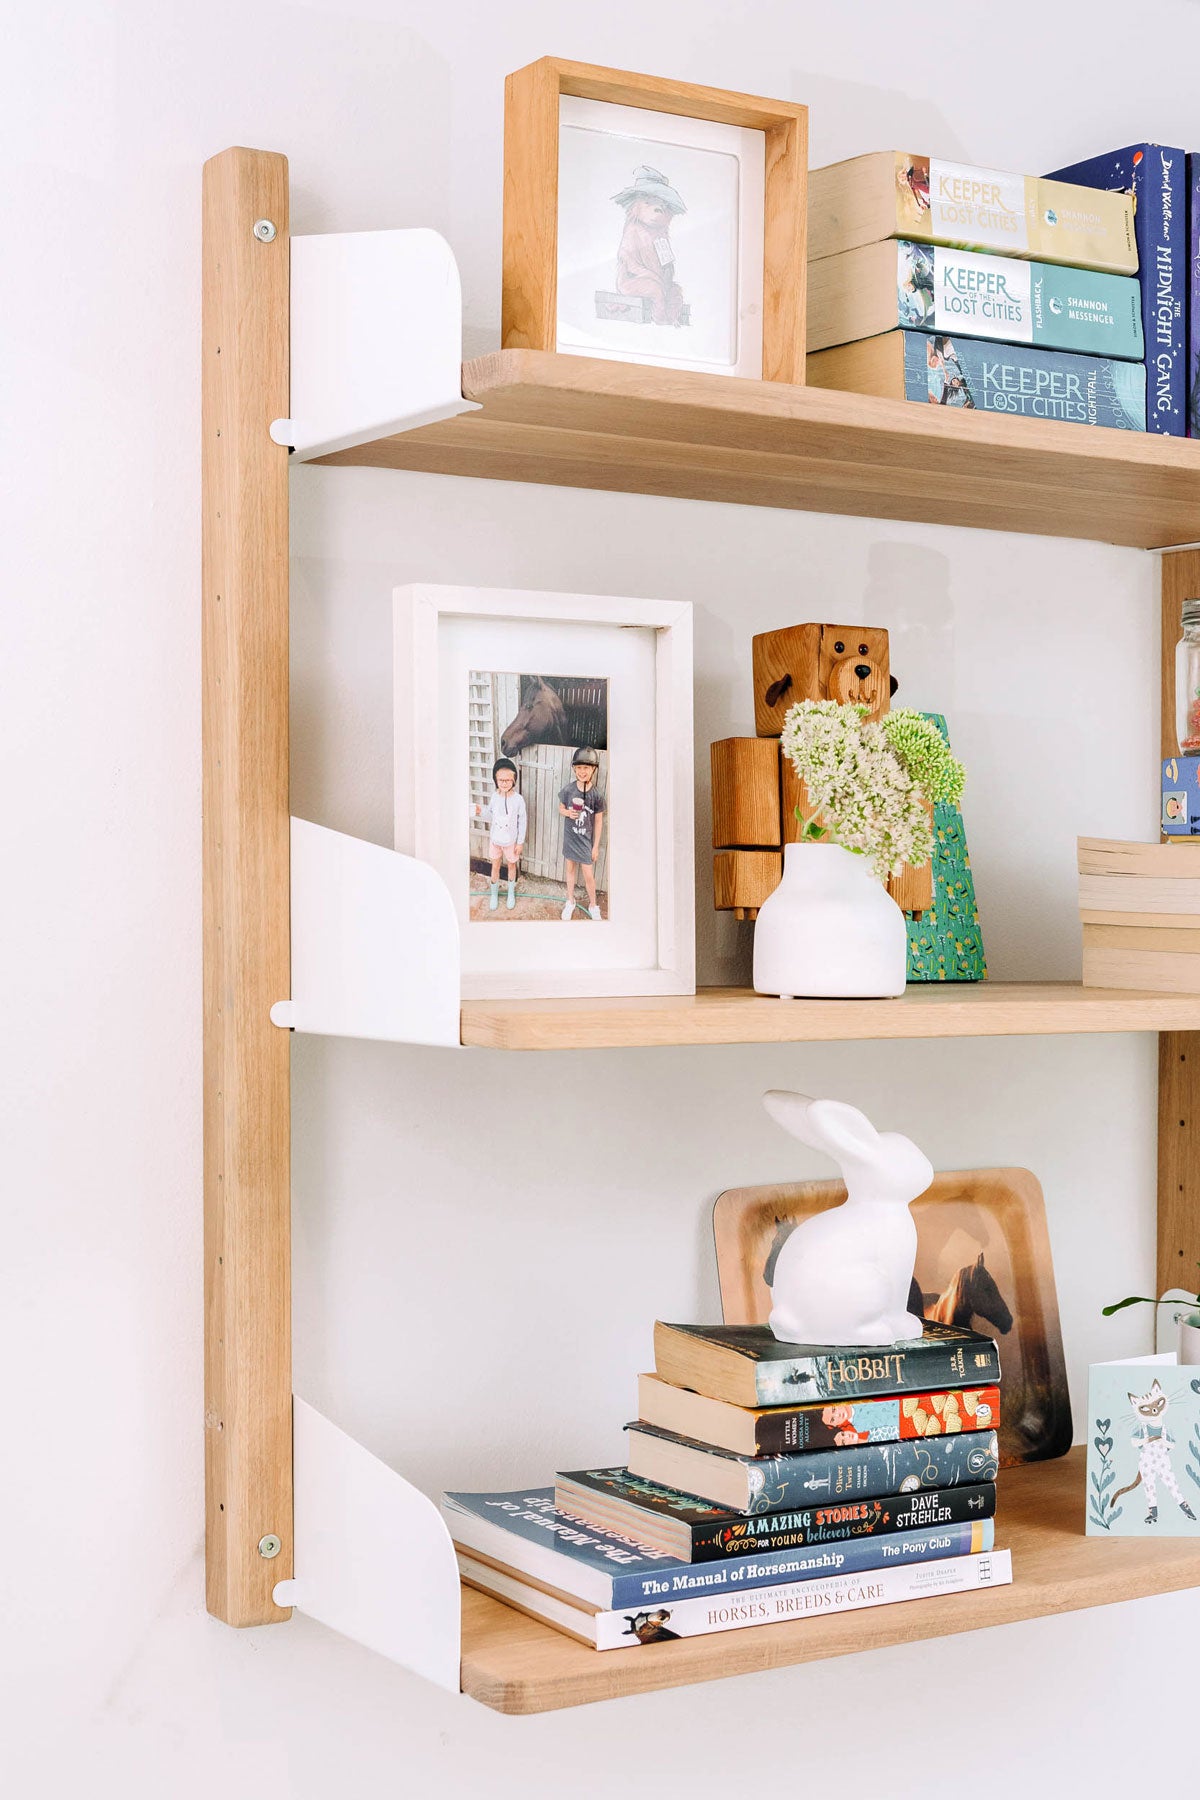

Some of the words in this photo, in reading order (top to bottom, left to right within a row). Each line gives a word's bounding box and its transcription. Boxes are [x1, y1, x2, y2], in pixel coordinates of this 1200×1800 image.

[938, 175, 1017, 214] KEEPER
[940, 205, 974, 225] LOST
[977, 208, 1018, 233] CITIES
[944, 266, 1021, 303] KEEPER
[979, 293, 992, 301] THE
[1157, 245, 1175, 347] MIDNIGHT
[944, 295, 978, 315] LOST
[982, 298, 1023, 322] CITIES
[1034, 277, 1043, 329] FLASHBACK
[1067, 297, 1108, 312] SHANNON
[1068, 310, 1115, 325] MESSENGER
[982, 362, 1086, 402] KEEPER
[1157, 353, 1173, 412] GANG
[983, 390, 1027, 413] LOST
[1031, 396, 1088, 421] CITIES
[957, 1348, 966, 1378] TOLKIEN
[835, 1464, 844, 1495] Oliver
[845, 1465, 853, 1492] Twist
[485, 1499, 521, 1512] of
[911, 1494, 939, 1511] DAVE
[509, 1510, 602, 1546] Manual
[746, 1512, 812, 1536] AMAZING
[815, 1504, 869, 1526] STORIES
[896, 1507, 952, 1528] STREHLER
[757, 1539, 770, 1548] FOR
[771, 1533, 804, 1547] YOUNG
[806, 1525, 851, 1543] believers
[882, 1545, 900, 1557] The
[902, 1540, 928, 1554] Pony
[929, 1537, 952, 1549] Club
[594, 1544, 643, 1565] The
[642, 1580, 670, 1595] The
[672, 1570, 728, 1591] Manual
[730, 1568, 745, 1581] of
[747, 1552, 845, 1580] Horsemanship
[708, 1602, 771, 1625] HORSES,
[775, 1592, 832, 1614] BREEDS
[835, 1590, 845, 1605] &
[847, 1583, 885, 1602] CARE
[731, 1596, 746, 1605] THE
[749, 1589, 788, 1602] ULTIMATE
[791, 1580, 848, 1596] ENCYCLOPEDIA
[851, 1578, 861, 1586] OF
